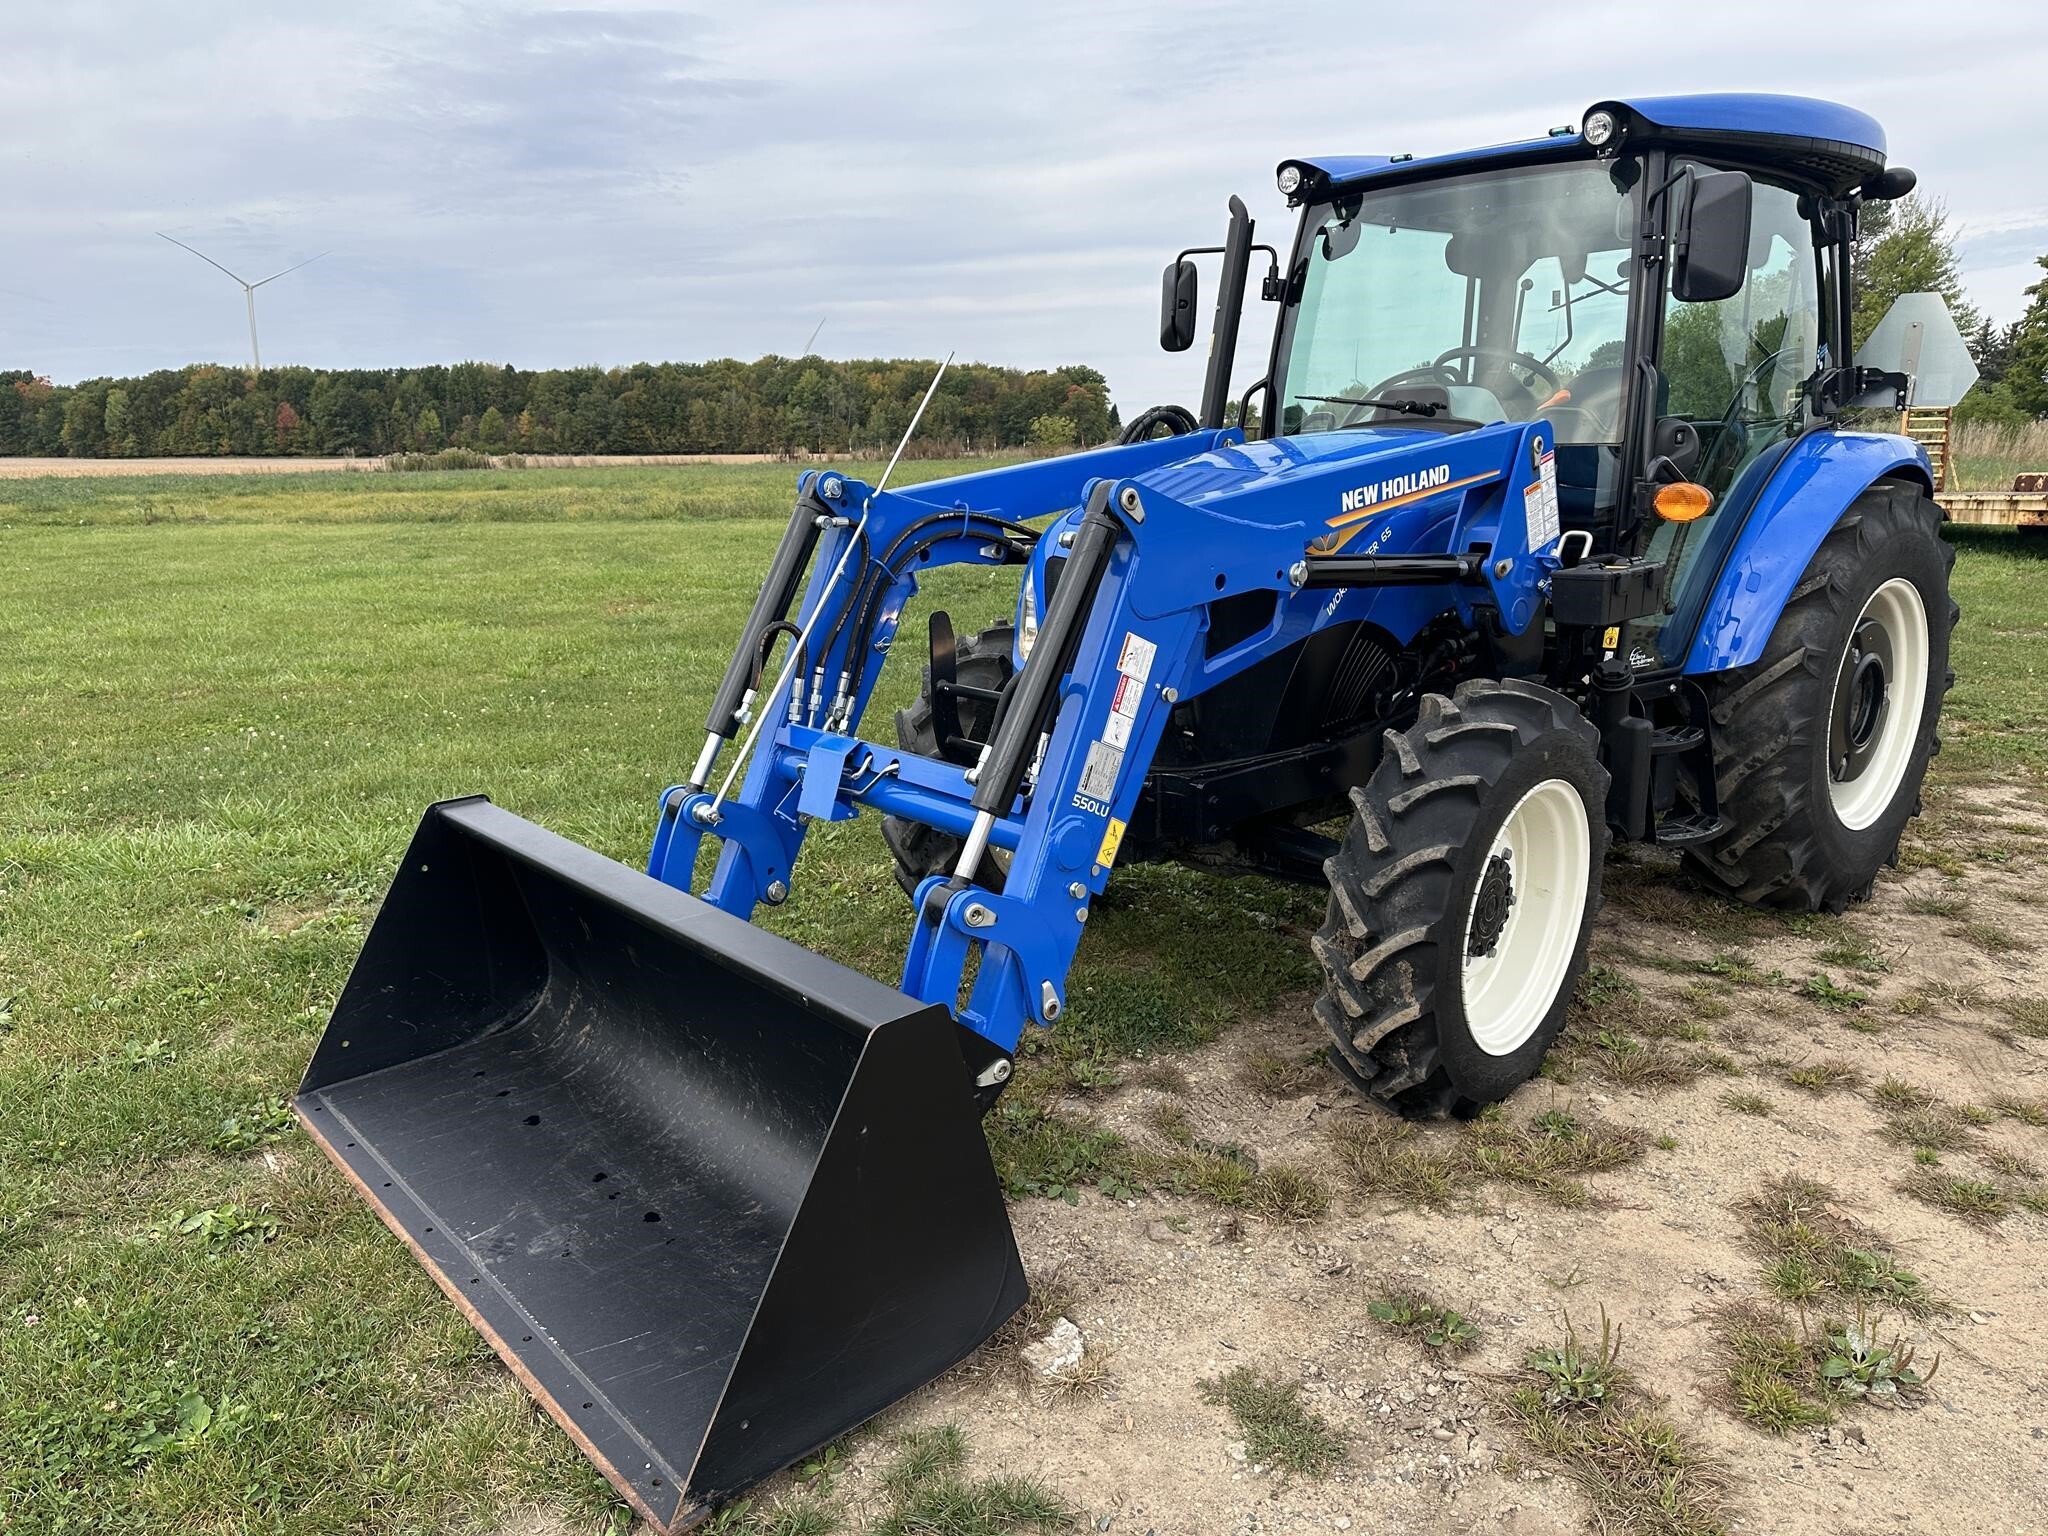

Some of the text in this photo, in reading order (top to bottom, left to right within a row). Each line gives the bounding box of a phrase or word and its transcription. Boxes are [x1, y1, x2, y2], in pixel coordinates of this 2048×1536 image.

[1341, 464, 1450, 512] NEW HOLLAND
[1380, 526, 1392, 542] 65
[1071, 794, 1110, 818] 550LU
